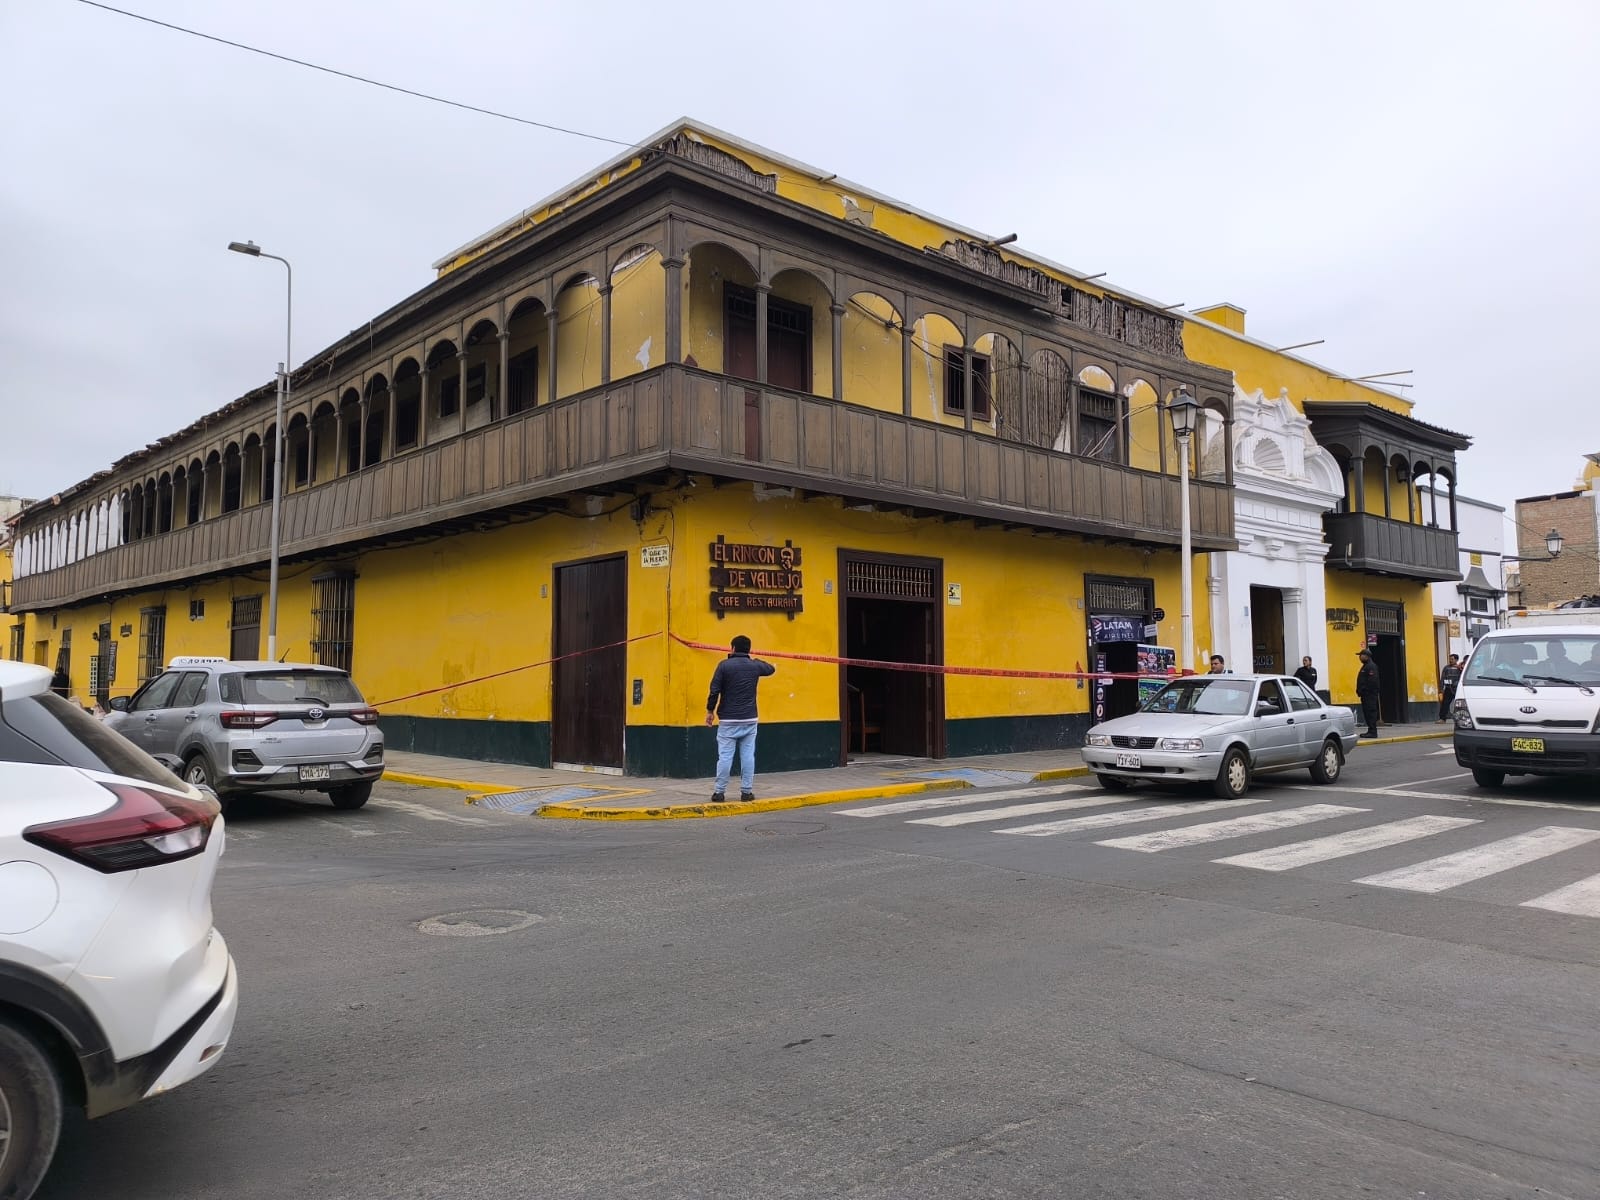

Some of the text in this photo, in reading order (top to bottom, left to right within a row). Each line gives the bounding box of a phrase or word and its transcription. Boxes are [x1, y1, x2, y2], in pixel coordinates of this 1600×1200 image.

[714, 544, 775, 564] EL RINCON
[729, 571, 800, 590] DE VALLEJO
[718, 596, 798, 609] CAFE RESTAURANT
[1103, 621, 1133, 630] LATAM
[300, 768, 329, 778] CMA-172
